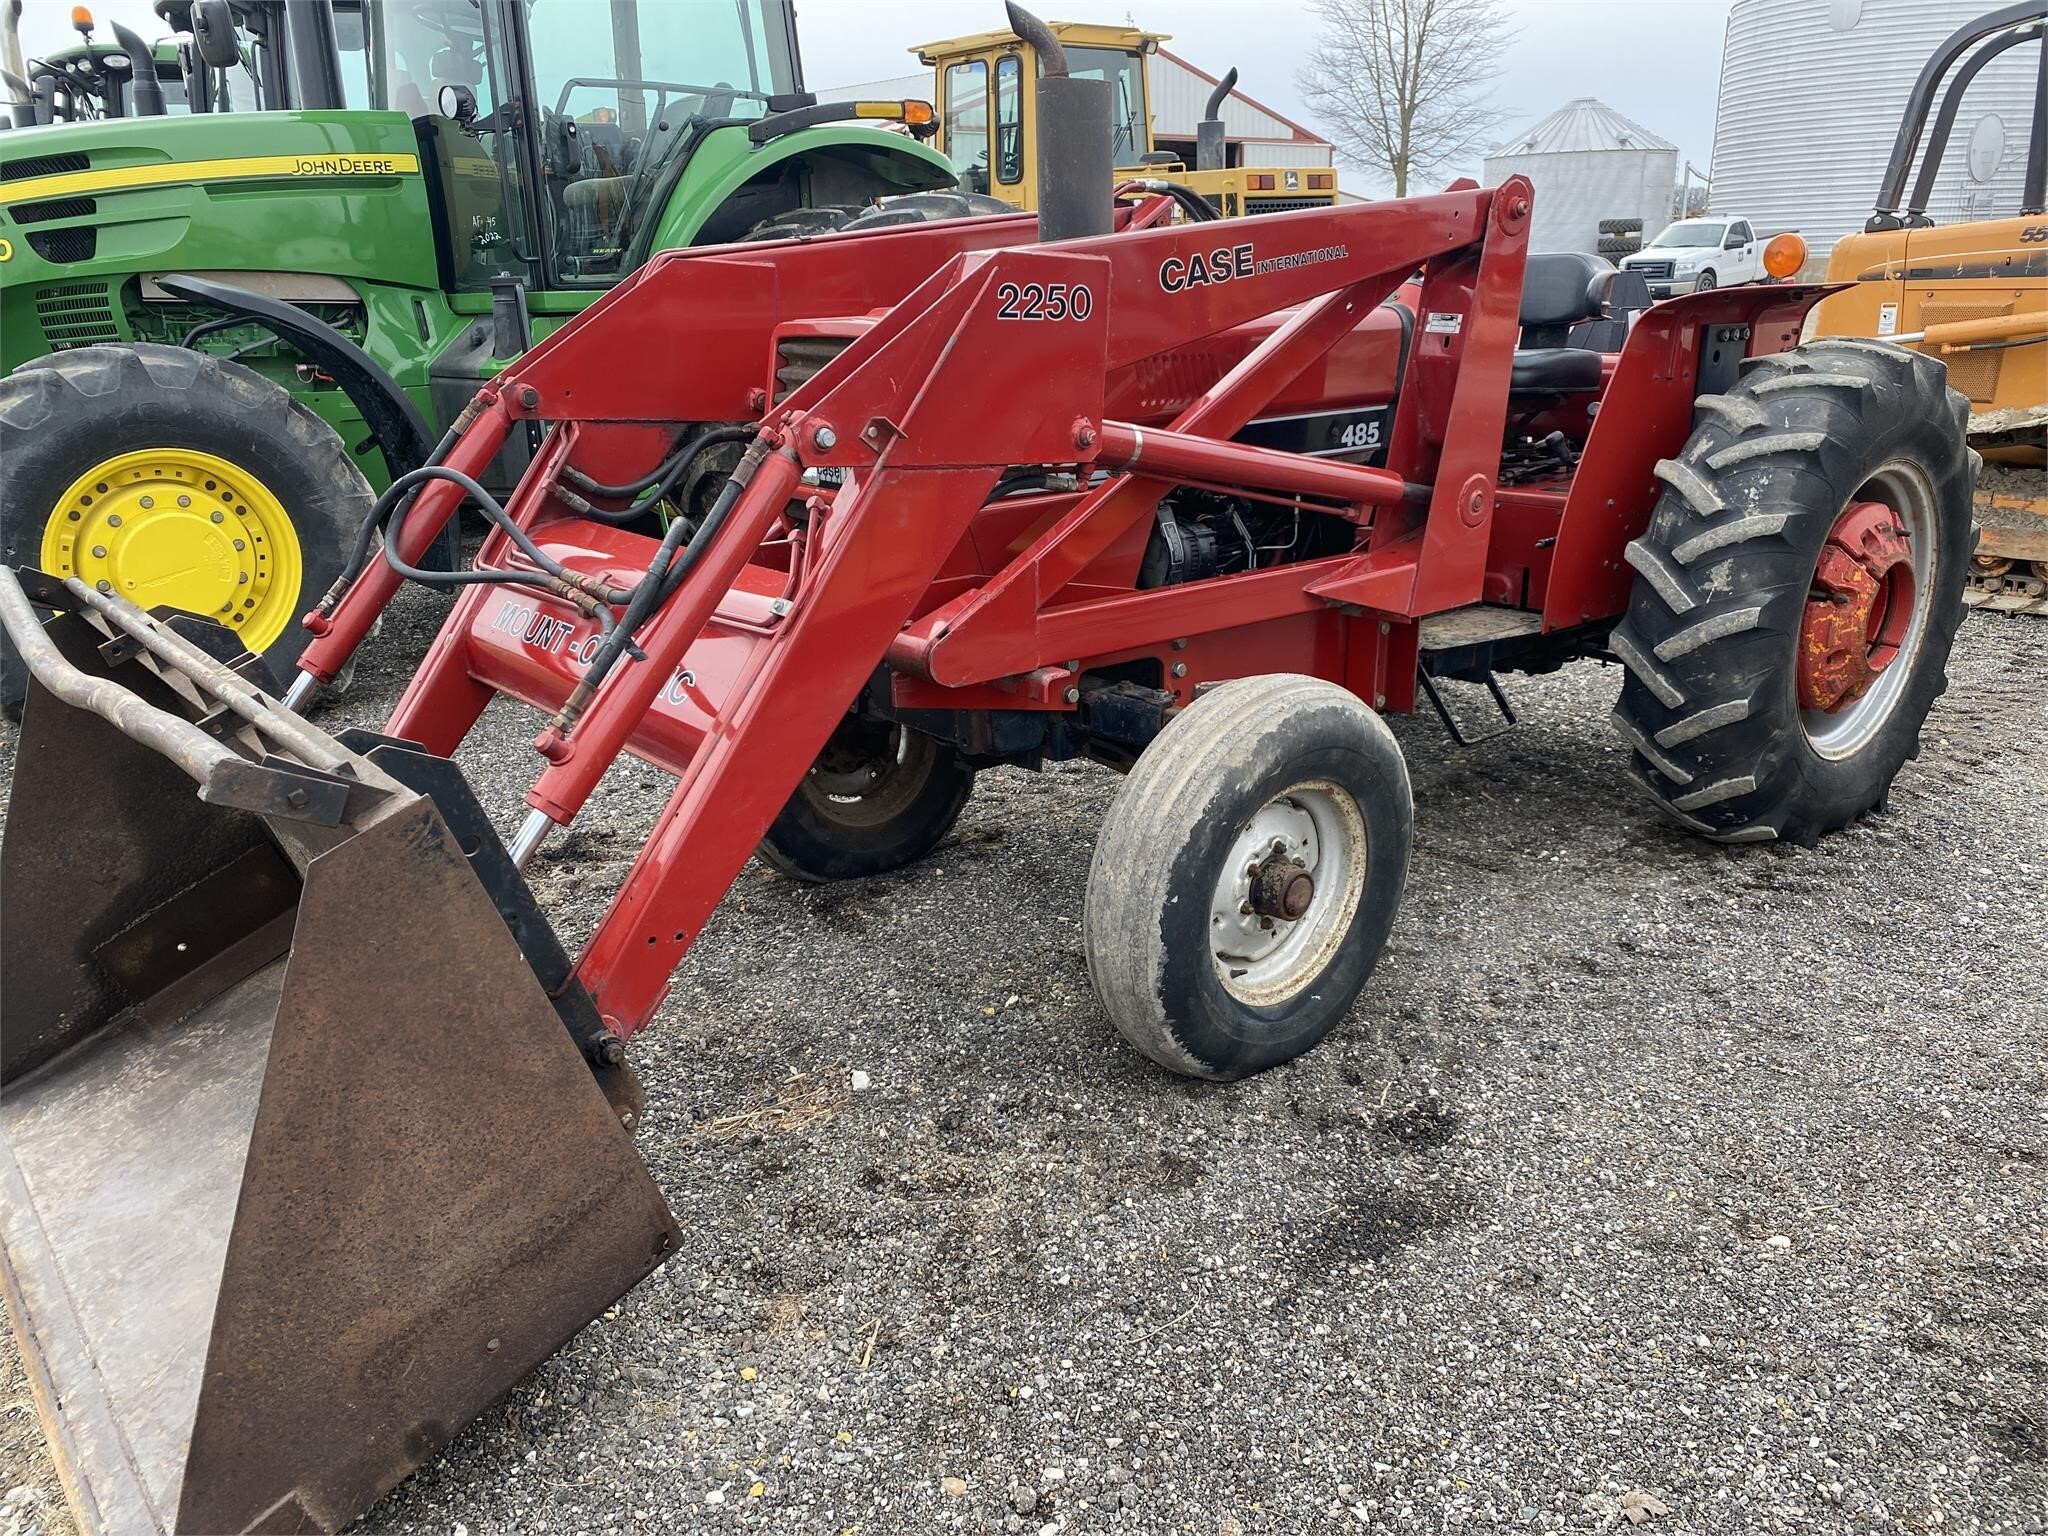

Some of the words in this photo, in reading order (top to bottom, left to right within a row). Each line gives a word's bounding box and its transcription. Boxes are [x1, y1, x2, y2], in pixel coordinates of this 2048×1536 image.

[291, 159, 338, 174] JOHN
[338, 158, 394, 172] DEERE
[478, 231, 502, 245] 2022
[1159, 243, 1254, 293] CASE
[1255, 245, 1349, 275] INTERNATIONAL
[997, 282, 1093, 321] 2250
[1341, 421, 1380, 447] 485
